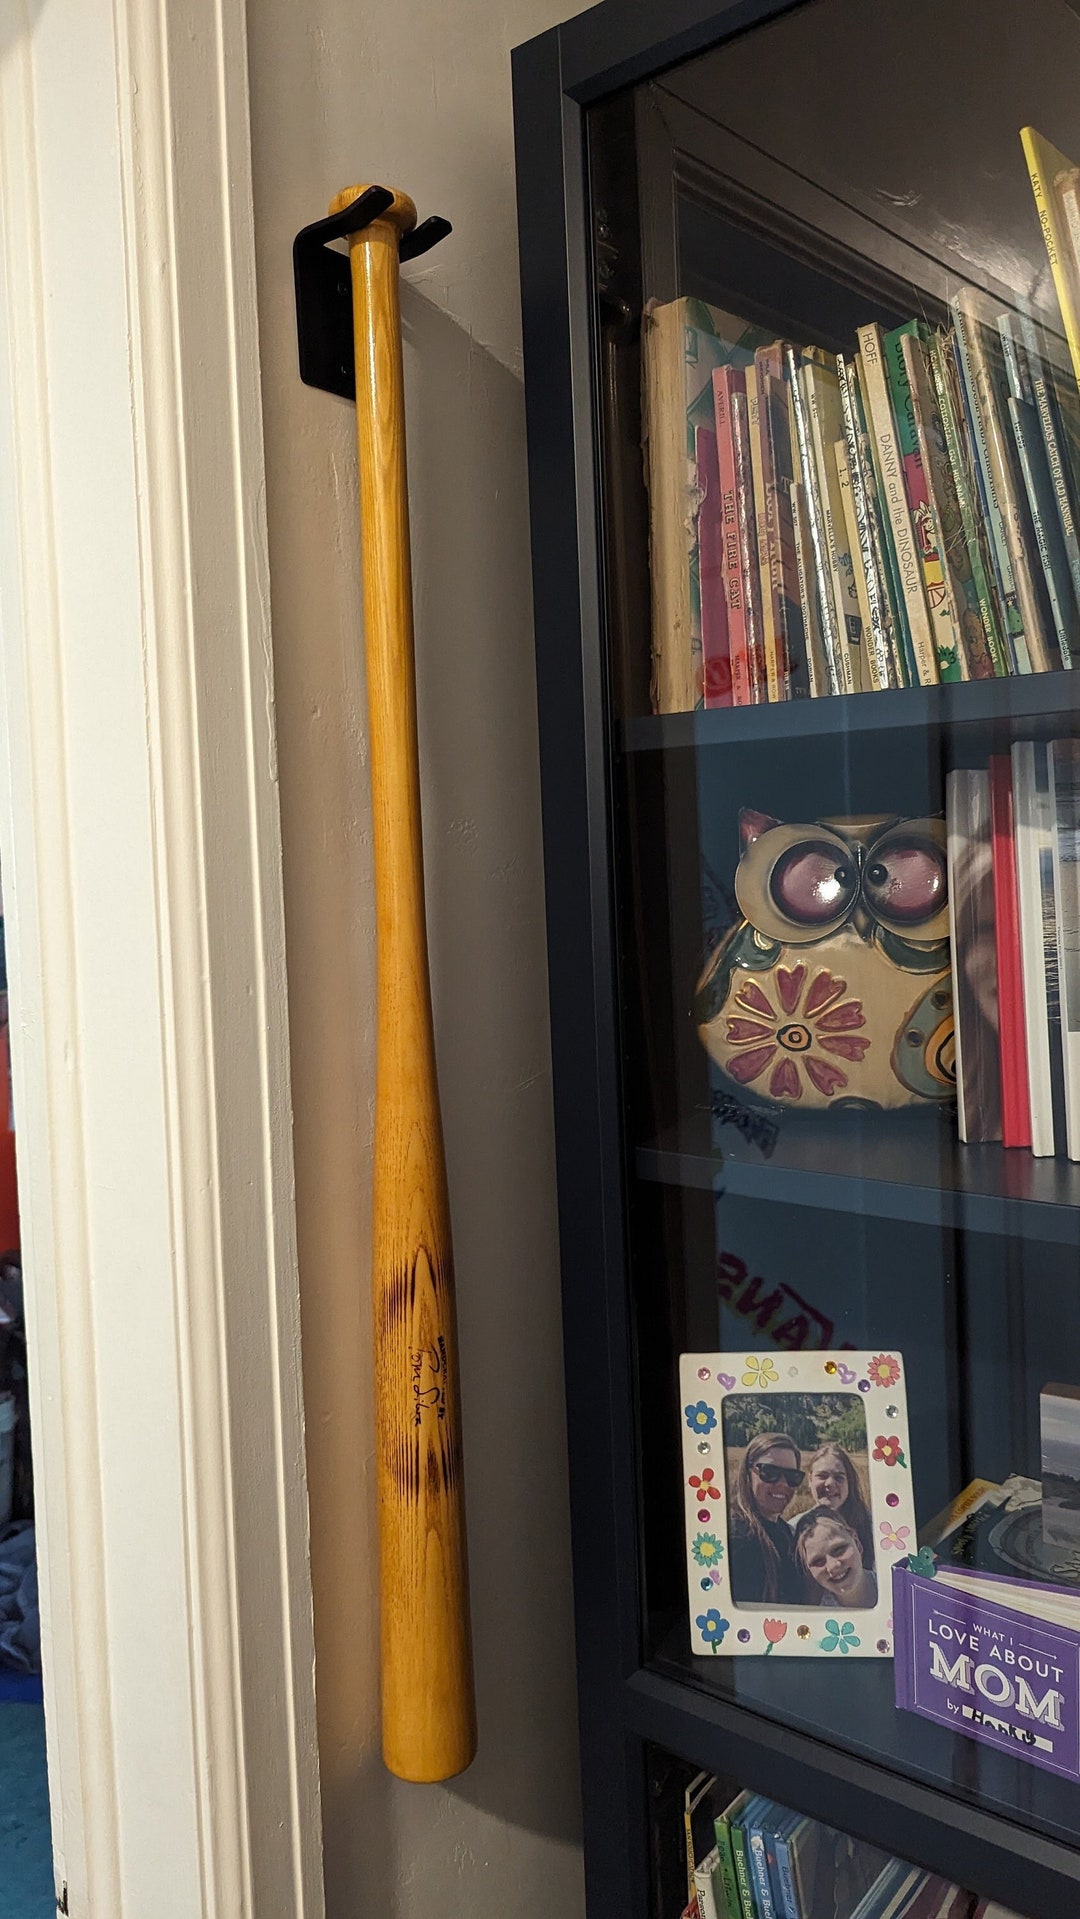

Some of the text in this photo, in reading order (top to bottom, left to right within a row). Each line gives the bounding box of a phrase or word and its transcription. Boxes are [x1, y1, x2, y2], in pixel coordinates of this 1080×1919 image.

[1029, 172, 1058, 266] KATY NO-POCKET
[863, 332, 878, 366] HOFF
[929, 349, 939, 369] HOW
[717, 390, 727, 426] AVERILL
[948, 449, 957, 465] GOT
[952, 468, 961, 483] HIS
[1034, 378, 1074, 537] THE MARVELOUS CATCH OF OLD HANNIBAL
[880, 434, 918, 594] DANNY and the DINOSAUR
[723, 490, 742, 610] THE FIRE CAT
[1032, 510, 1070, 662] THE MAGIC FISH Littledale
[864, 625, 879, 684] WONDER BOOKS
[918, 641, 930, 668] Harper
[978, 598, 998, 664] WONDER BOOKS
[843, 652, 853, 685] CUSHMAN
[923, 669, 930, 677] &
[928, 1618, 1063, 1683] LOVE ABOUT
[972, 1623, 1014, 1646] WHAT I
[929, 1641, 1065, 1731] MOM
[946, 1697, 960, 1715] by
[736, 1850, 755, 1919] Buehner & Bue
[754, 1850, 768, 1887] Buehner
[761, 1889, 769, 1897] &
